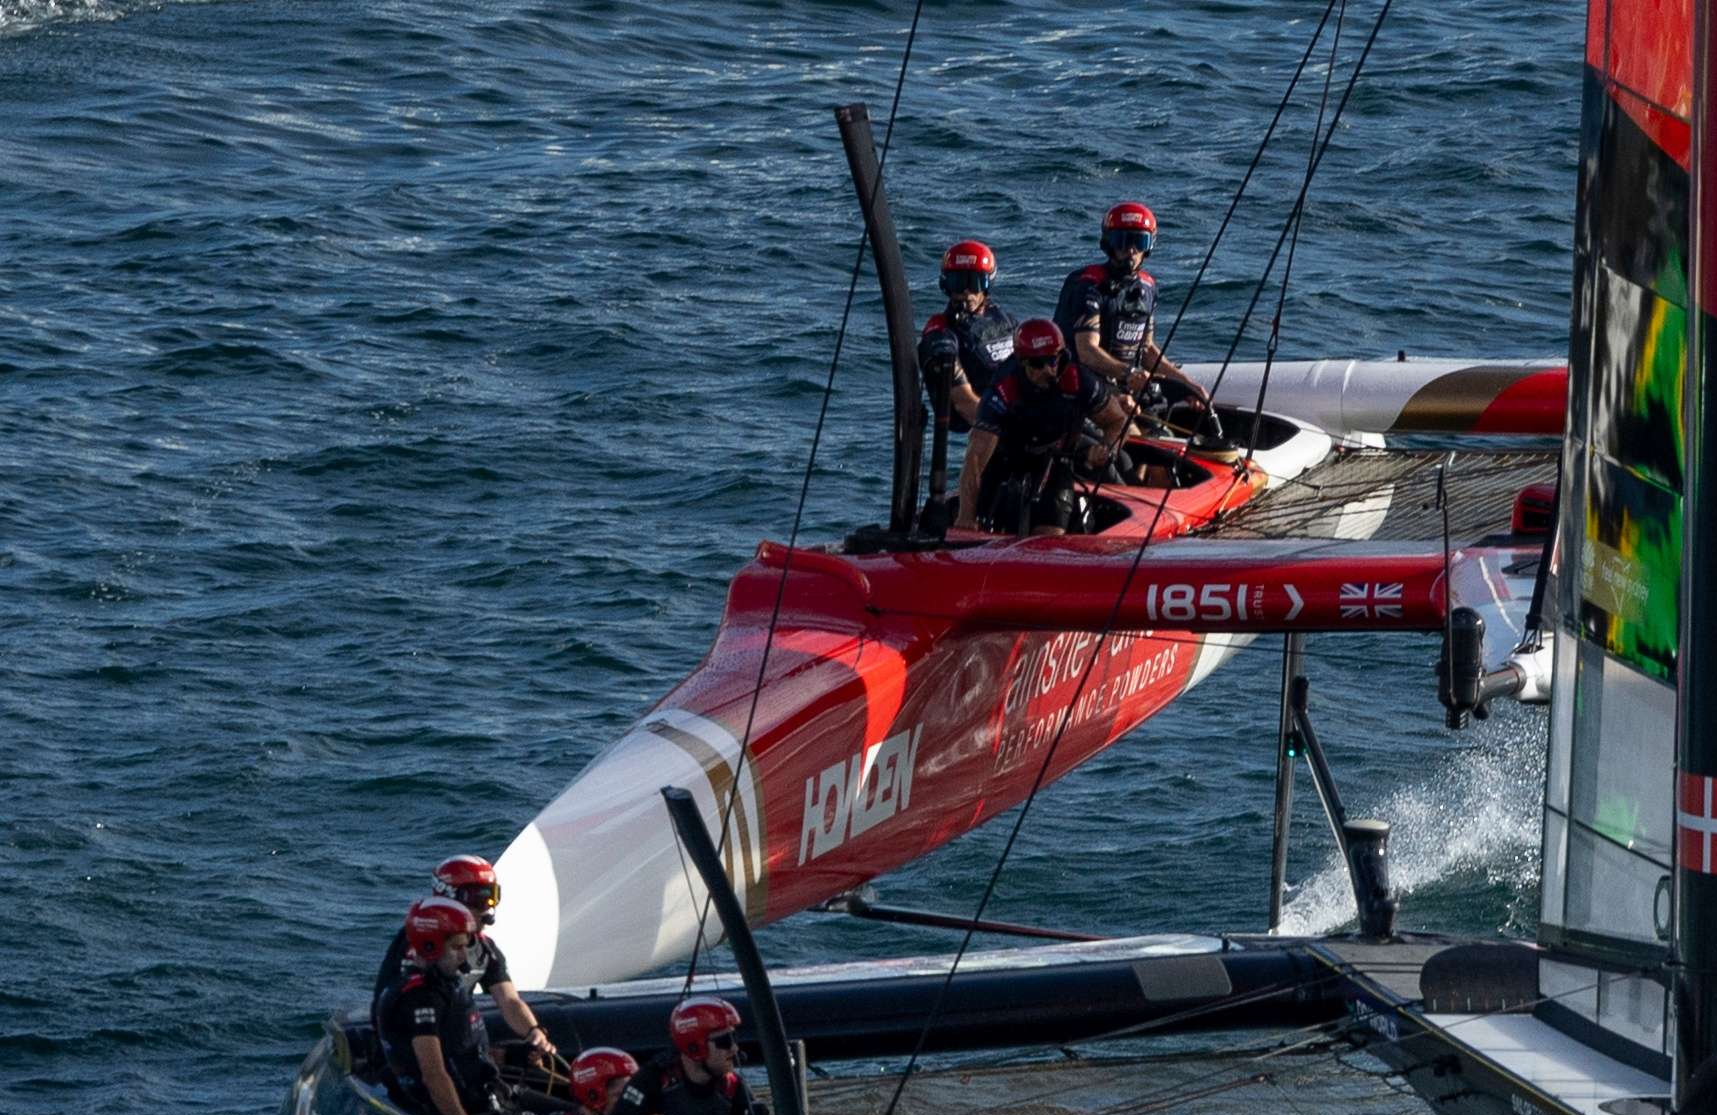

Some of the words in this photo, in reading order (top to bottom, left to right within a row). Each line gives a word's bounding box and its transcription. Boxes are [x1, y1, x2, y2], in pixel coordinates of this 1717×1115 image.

[1147, 584, 1248, 620] 1851
[994, 684, 1109, 772] PERFORMANCE
[1109, 643, 1178, 704] POWDERS
[800, 723, 922, 866] HOWDEN
